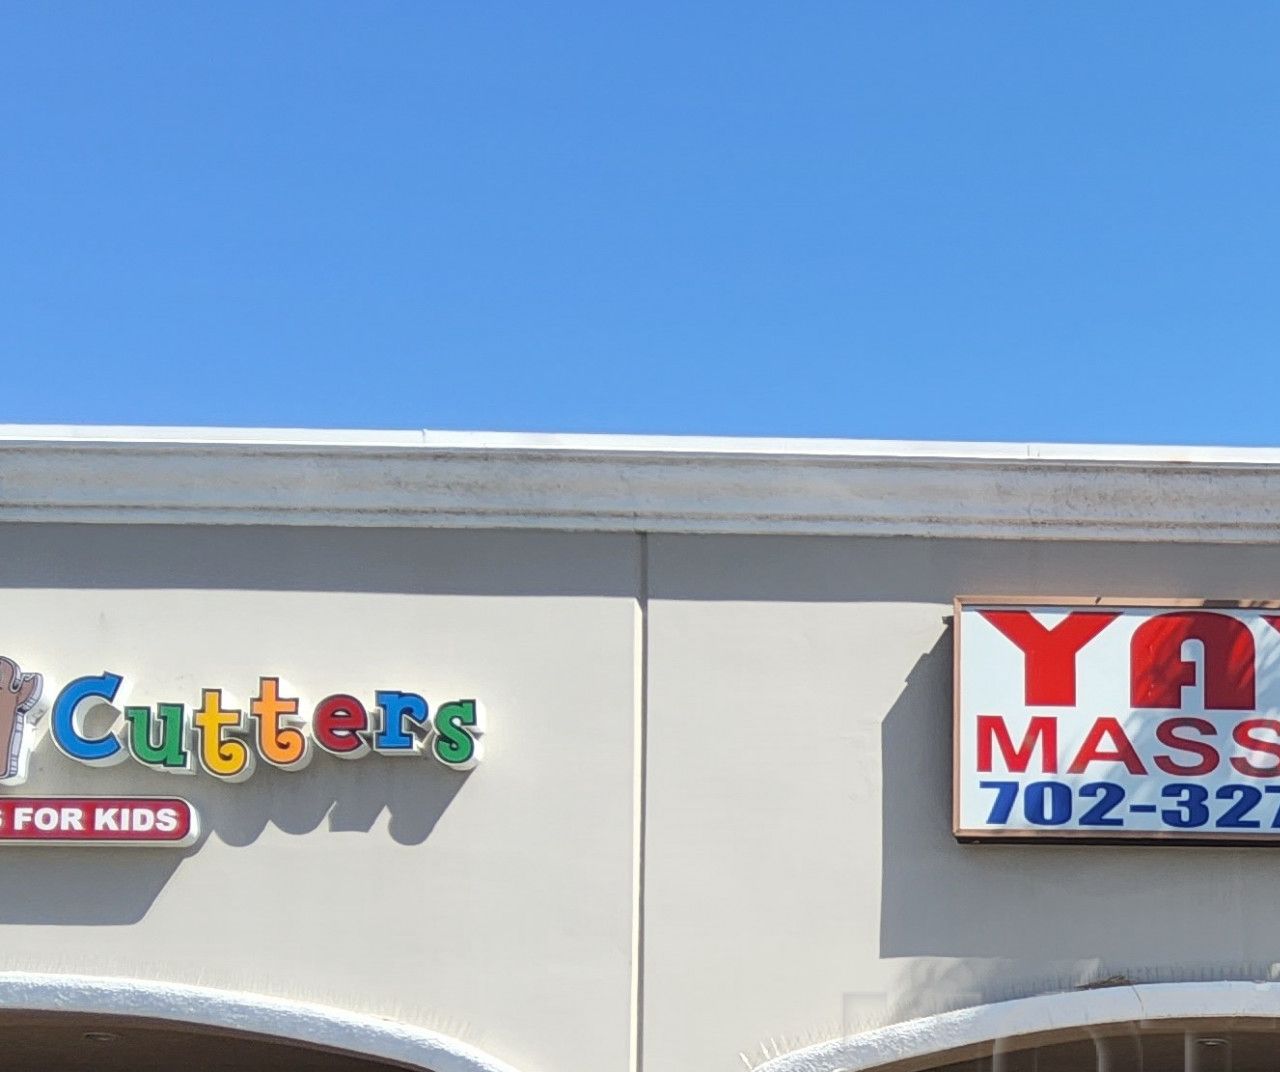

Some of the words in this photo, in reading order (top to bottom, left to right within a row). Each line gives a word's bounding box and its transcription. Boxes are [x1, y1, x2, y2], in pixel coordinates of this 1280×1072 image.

[51, 671, 477, 777] Cutters
[14, 807, 86, 831] FOR
[94, 807, 178, 832] KIDS
